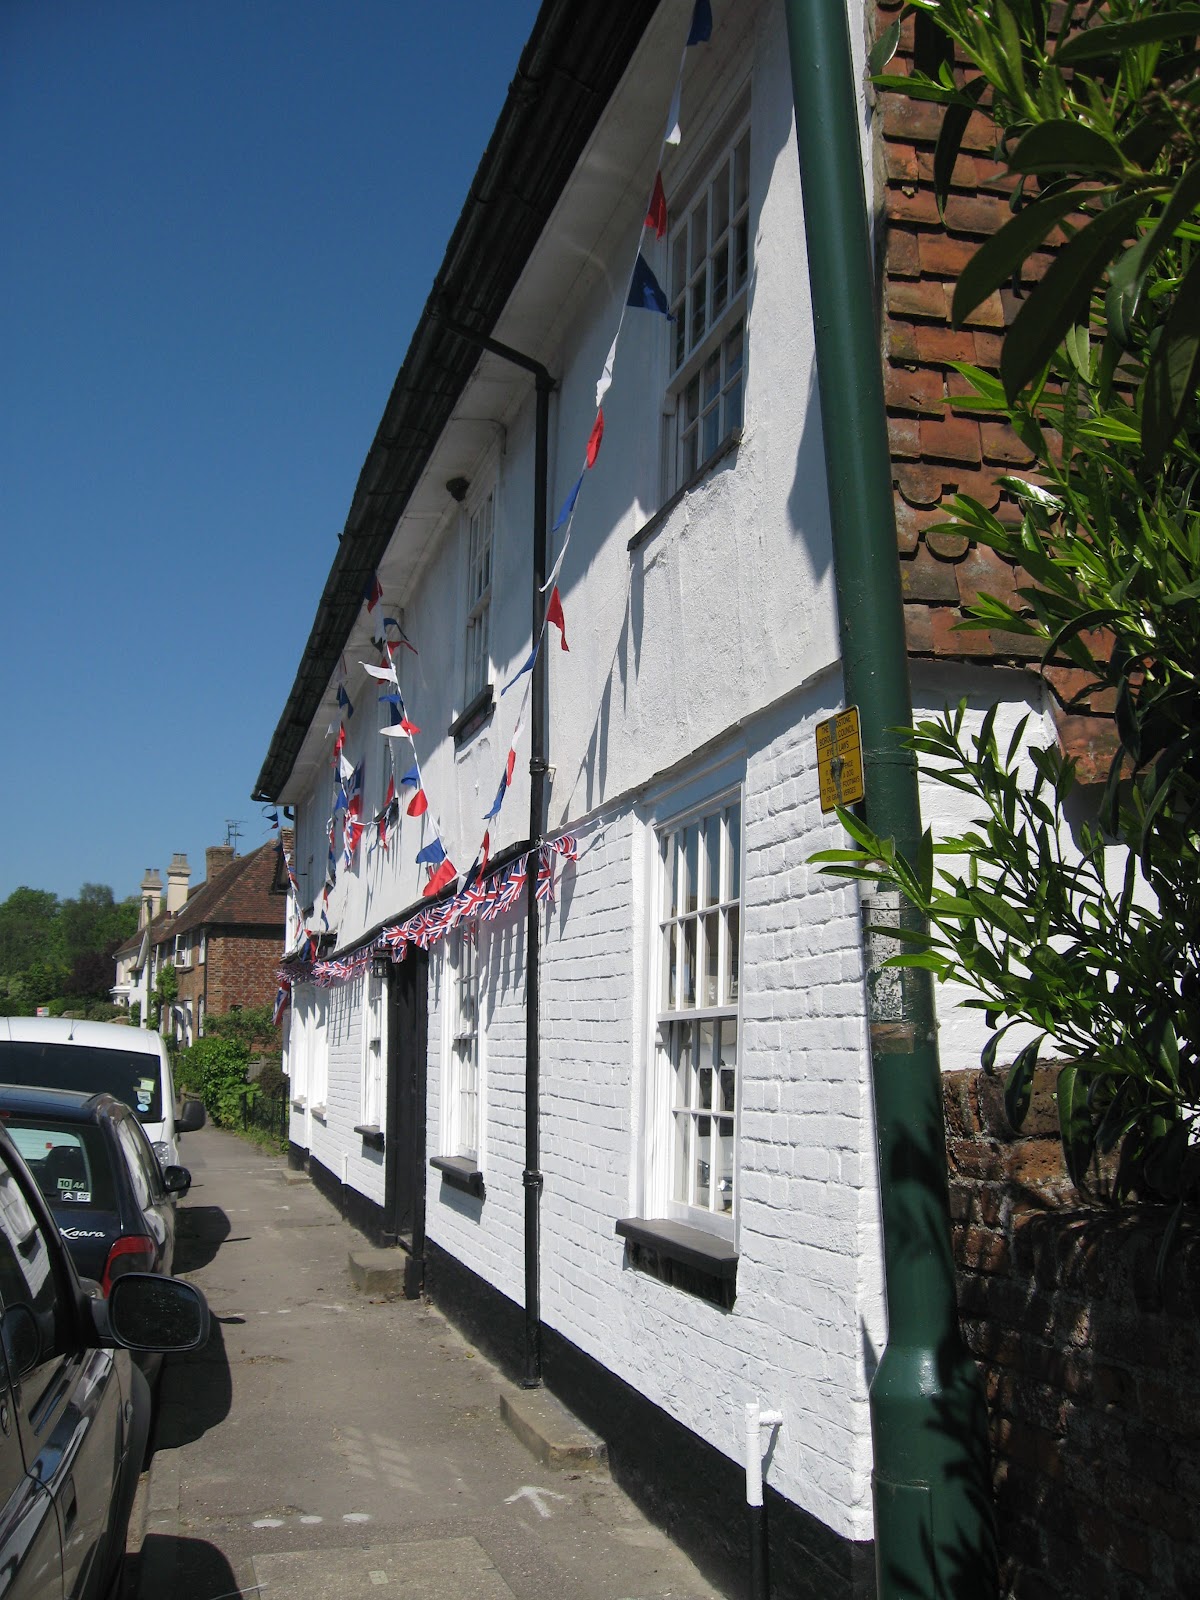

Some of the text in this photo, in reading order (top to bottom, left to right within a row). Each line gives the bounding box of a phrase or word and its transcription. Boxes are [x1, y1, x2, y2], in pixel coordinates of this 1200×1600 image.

[838, 725, 855, 738] COUNCIL
[59, 1180, 70, 1188] 10
[59, 1227, 106, 1240] Xsara
